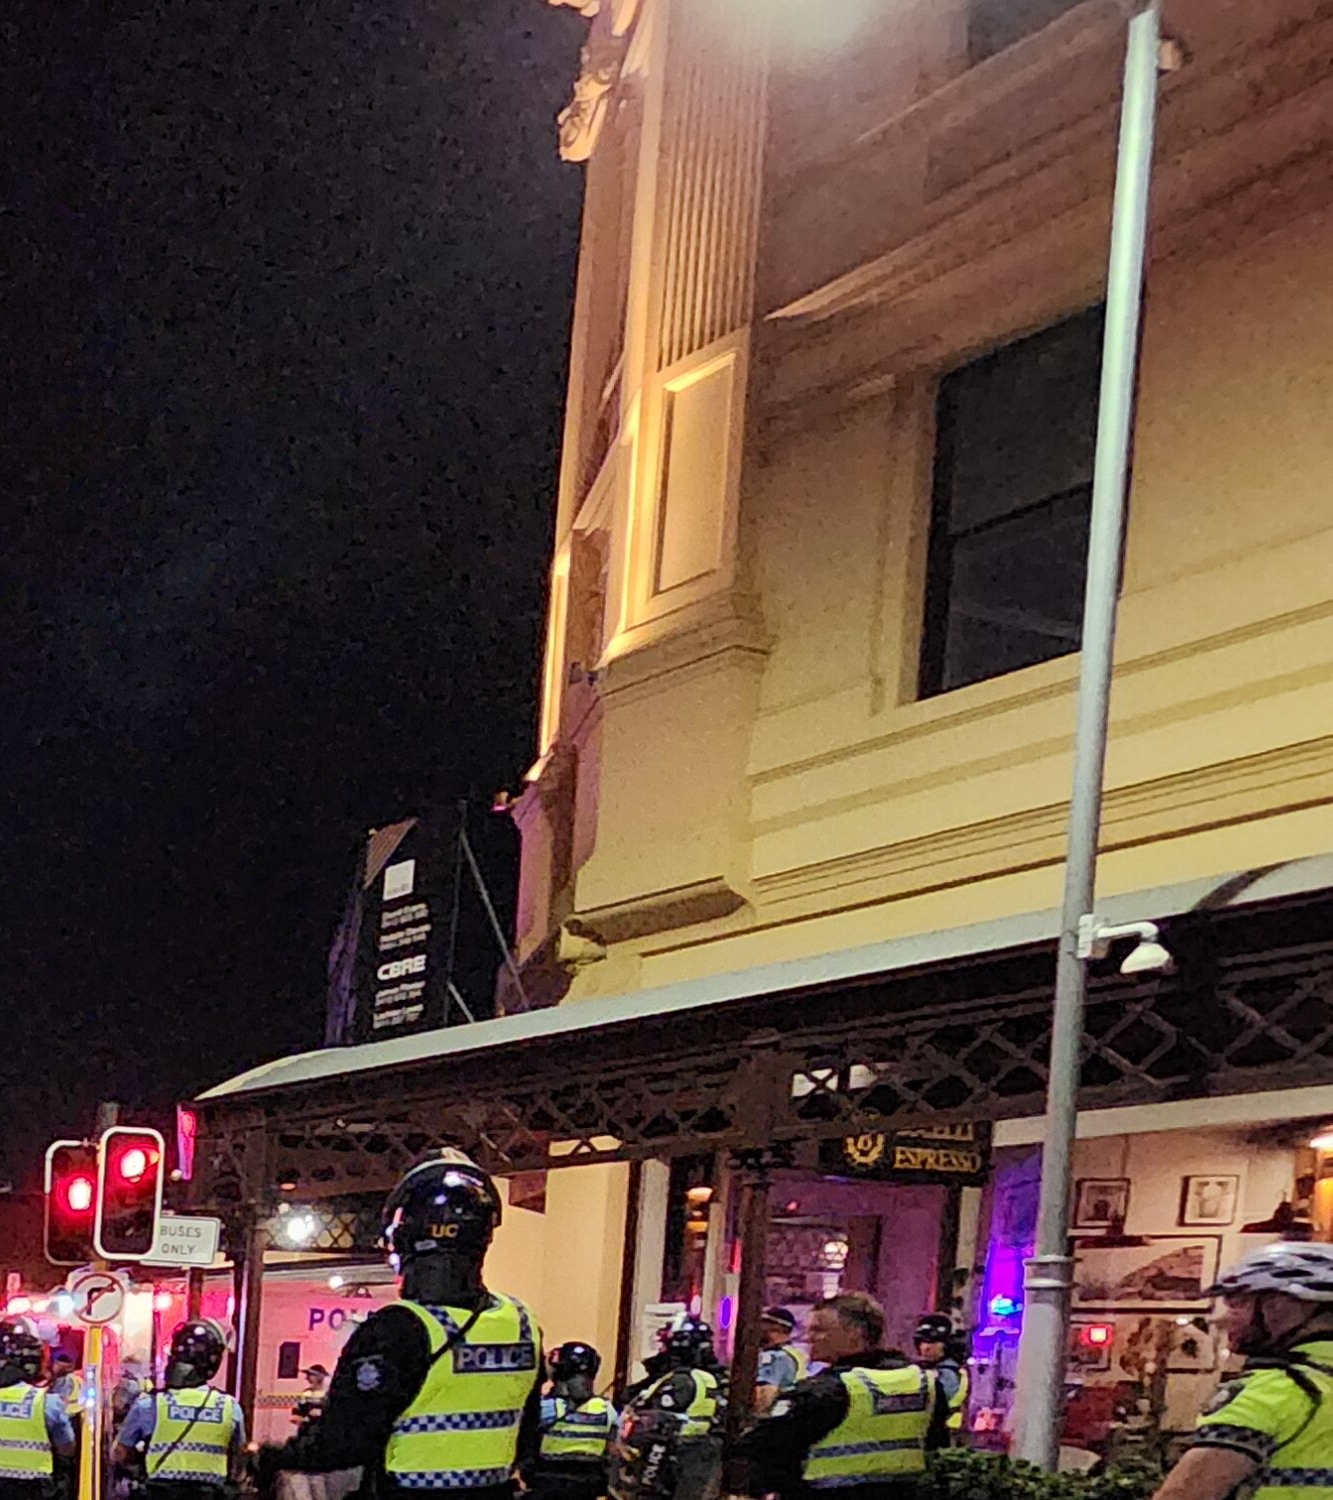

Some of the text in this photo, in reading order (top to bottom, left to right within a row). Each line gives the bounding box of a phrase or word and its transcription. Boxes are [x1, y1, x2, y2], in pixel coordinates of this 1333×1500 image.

[377, 954, 427, 980] CBRE
[893, 1146, 982, 1174] ESPRESSO
[160, 1225, 202, 1238] BUSES
[161, 1243, 196, 1255] ONLY
[457, 1346, 531, 1370] POLICE
